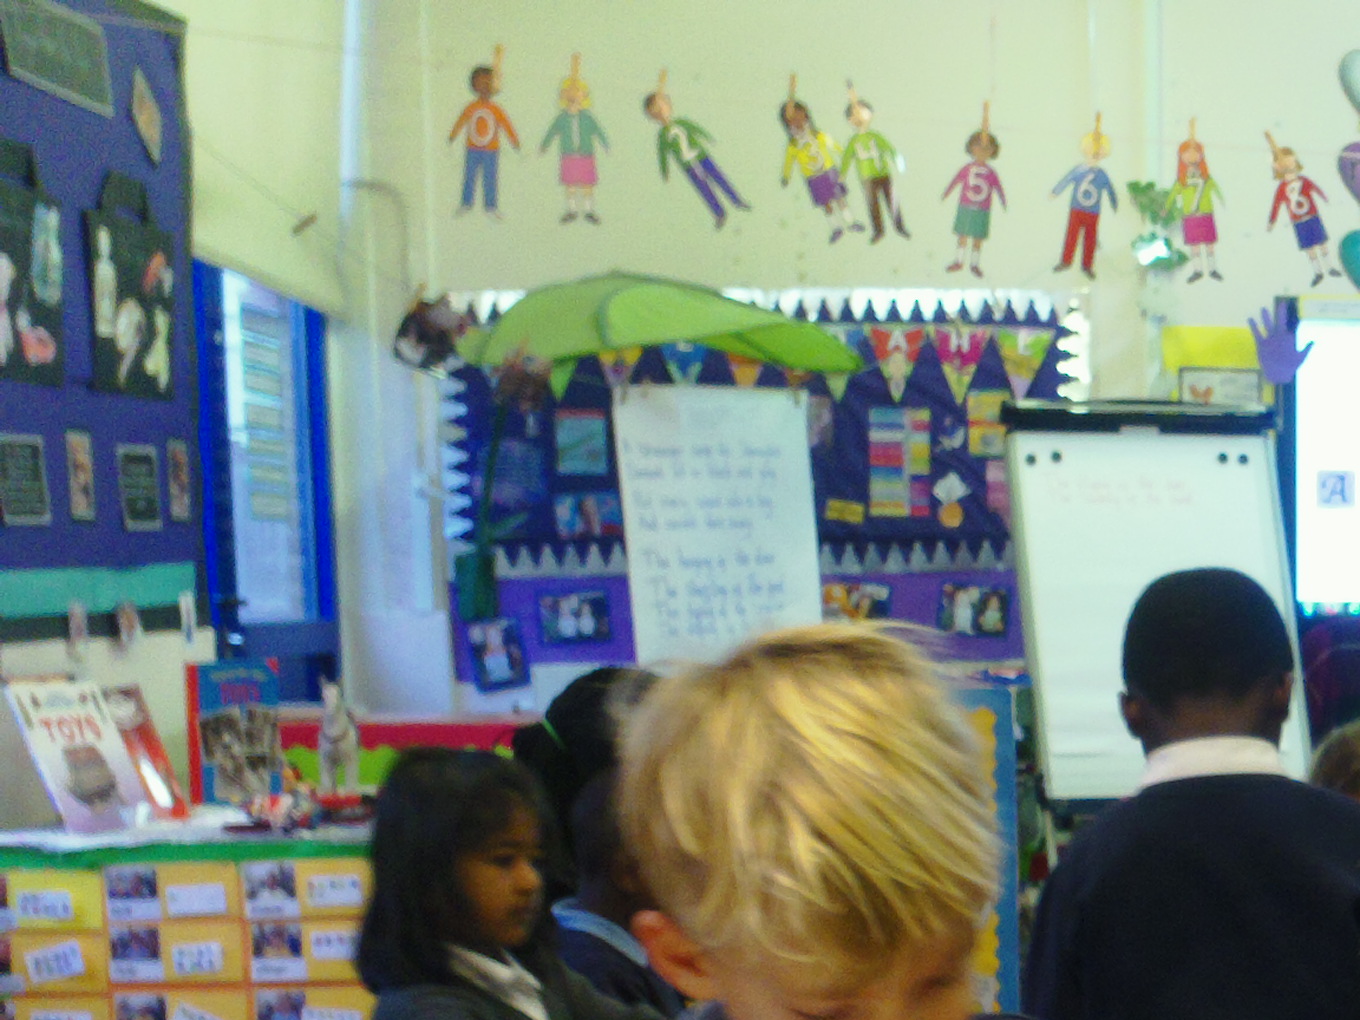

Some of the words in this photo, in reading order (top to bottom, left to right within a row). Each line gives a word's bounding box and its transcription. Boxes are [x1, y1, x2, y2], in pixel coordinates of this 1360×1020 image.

[668, 126, 700, 162] 2
[966, 166, 990, 202] 5
[1077, 172, 1099, 207] 6
[1285, 178, 1311, 215] 8
[38, 713, 103, 745] TOYS
